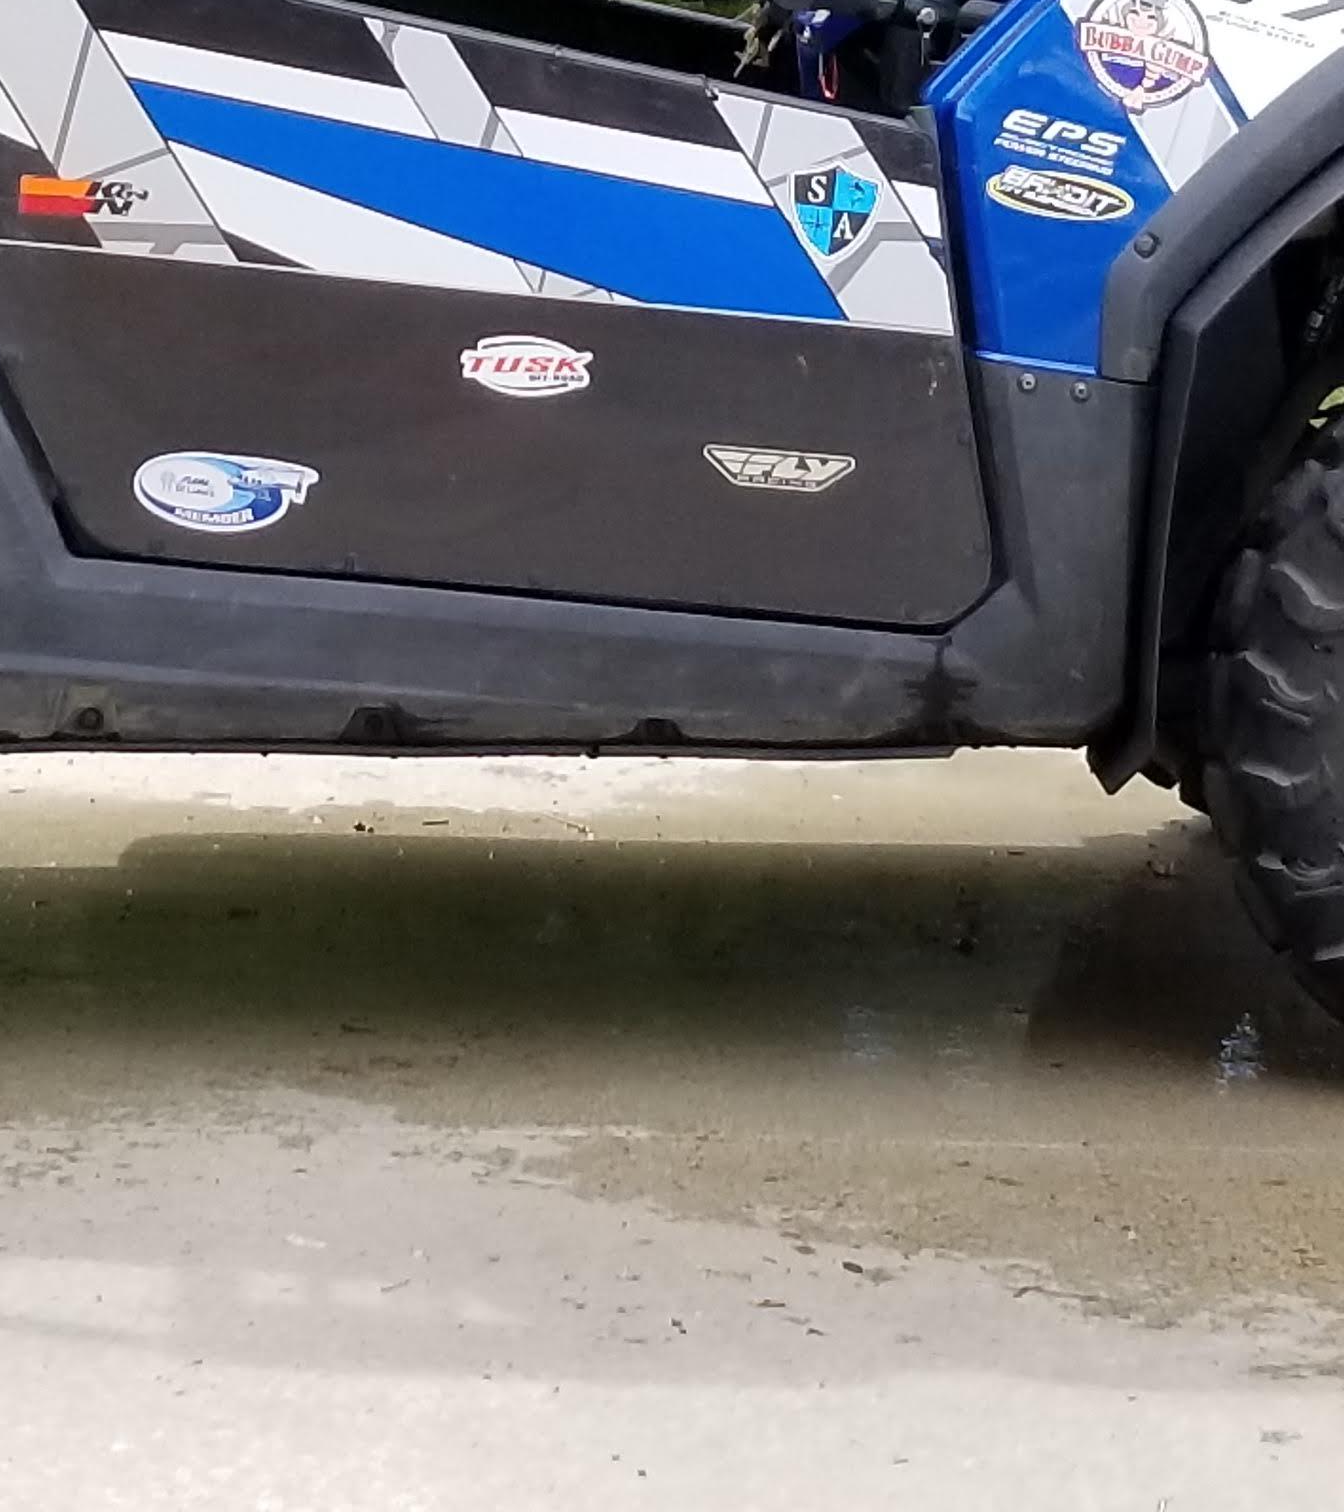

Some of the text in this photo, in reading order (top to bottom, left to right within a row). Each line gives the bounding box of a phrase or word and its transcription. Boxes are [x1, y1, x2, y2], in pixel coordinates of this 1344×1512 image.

[1085, 26, 1203, 74] BUBBA GUMP
[1002, 108, 1127, 157] EPS
[807, 165, 827, 193] S
[832, 212, 855, 239] A
[467, 355, 584, 373] TUSK
[709, 449, 849, 481] FLY
